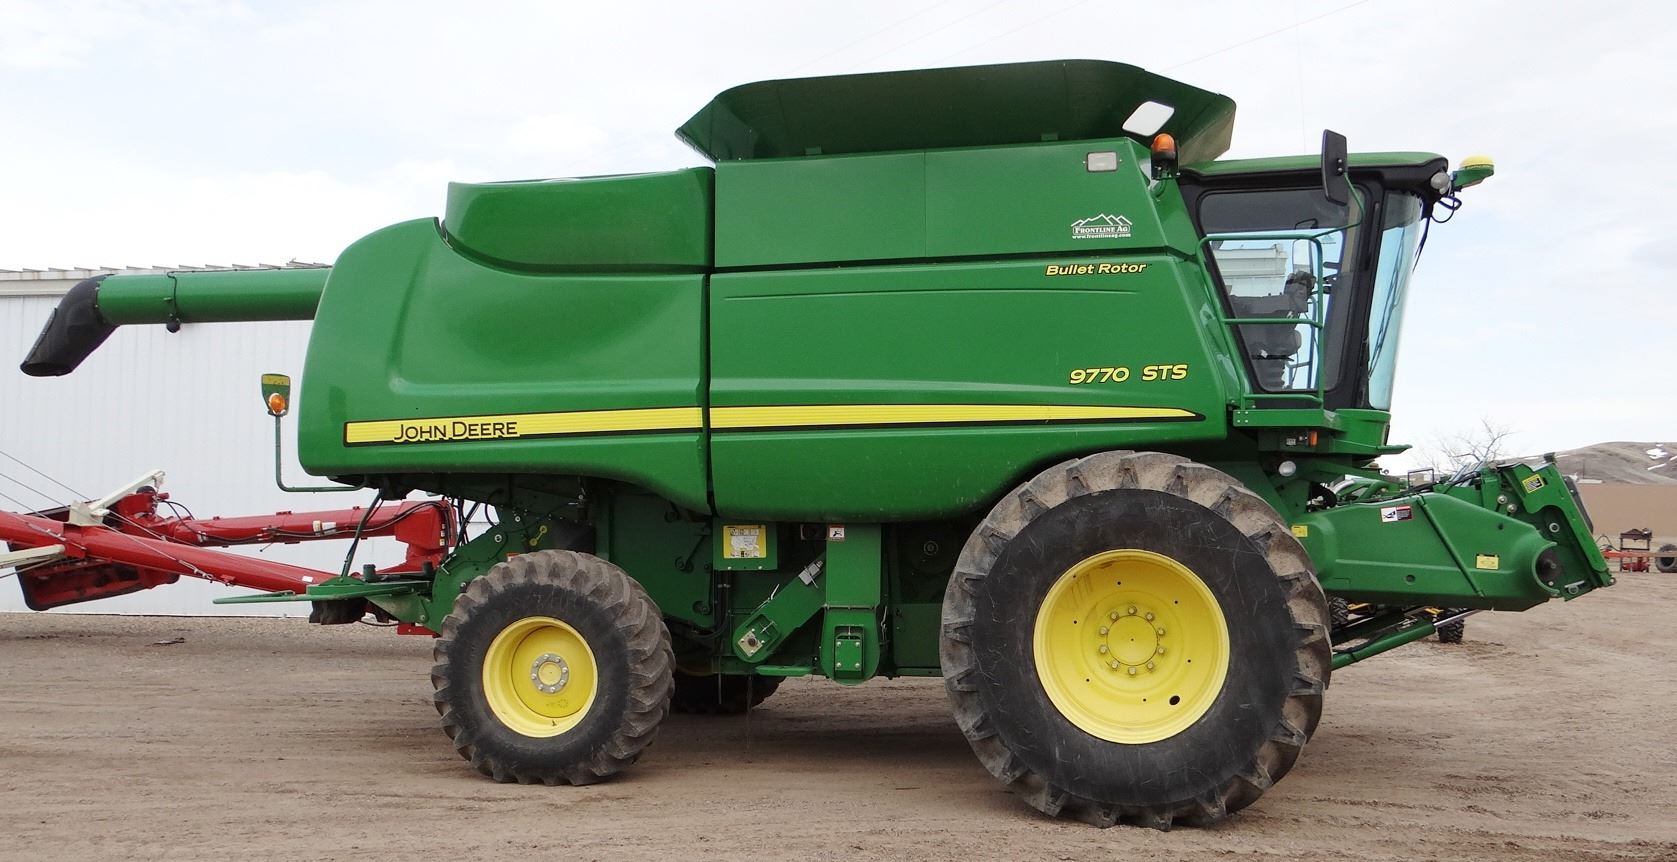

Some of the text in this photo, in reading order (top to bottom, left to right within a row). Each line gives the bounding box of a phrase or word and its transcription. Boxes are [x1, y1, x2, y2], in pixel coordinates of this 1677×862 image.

[1046, 263, 1147, 276] Bullet Rotor
[1069, 364, 1189, 384] 9770 STS
[394, 421, 518, 440] JOHN DEERE
